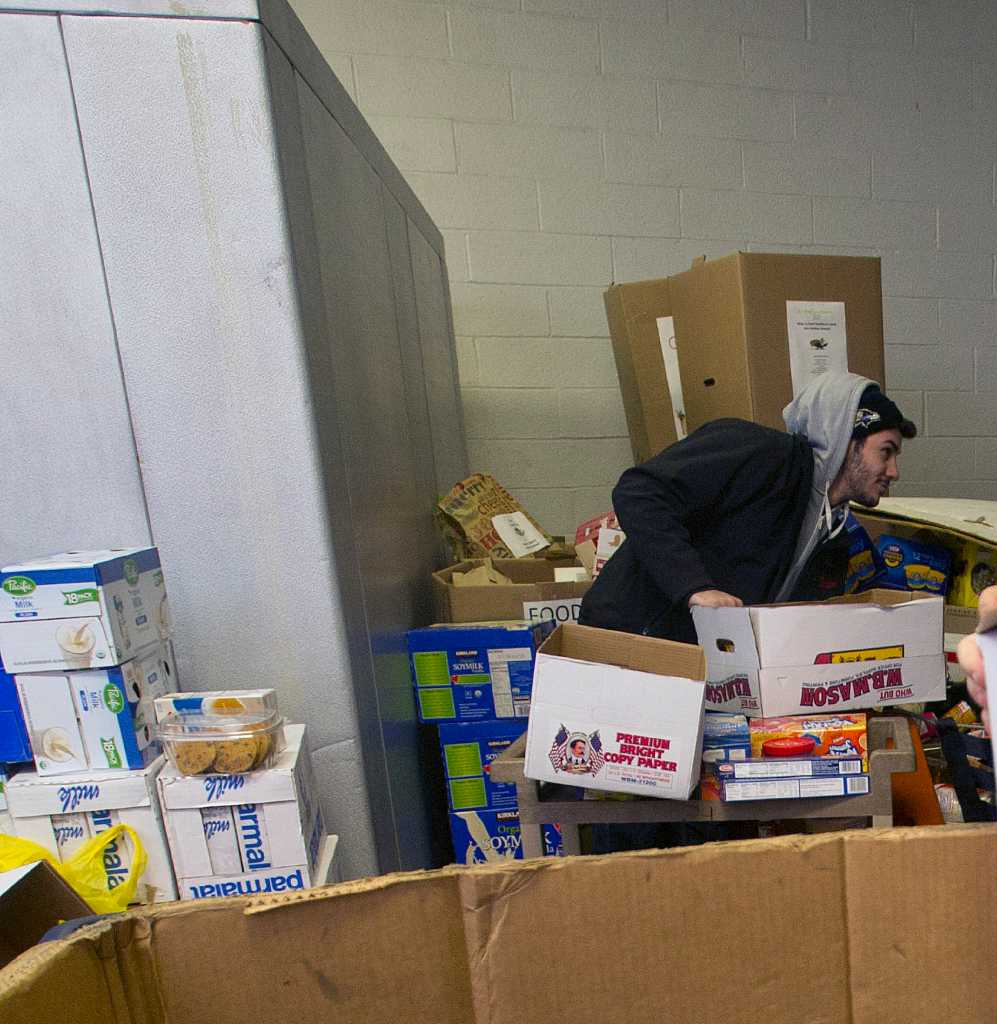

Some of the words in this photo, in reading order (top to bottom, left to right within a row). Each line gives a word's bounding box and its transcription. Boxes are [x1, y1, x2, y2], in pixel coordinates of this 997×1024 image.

[65, 593, 78, 604] 18
[452, 662, 484, 672] SOYMILK
[880, 689, 893, 699] BUT
[895, 688, 913, 697] WHO
[615, 731, 670, 750] PREMIUM
[619, 743, 665, 759] BRIGHT
[603, 751, 635, 766] COPY
[637, 755, 678, 772] PAPER
[203, 774, 247, 802] milk
[57, 784, 100, 812] milk
[497, 825, 521, 835] Orga
